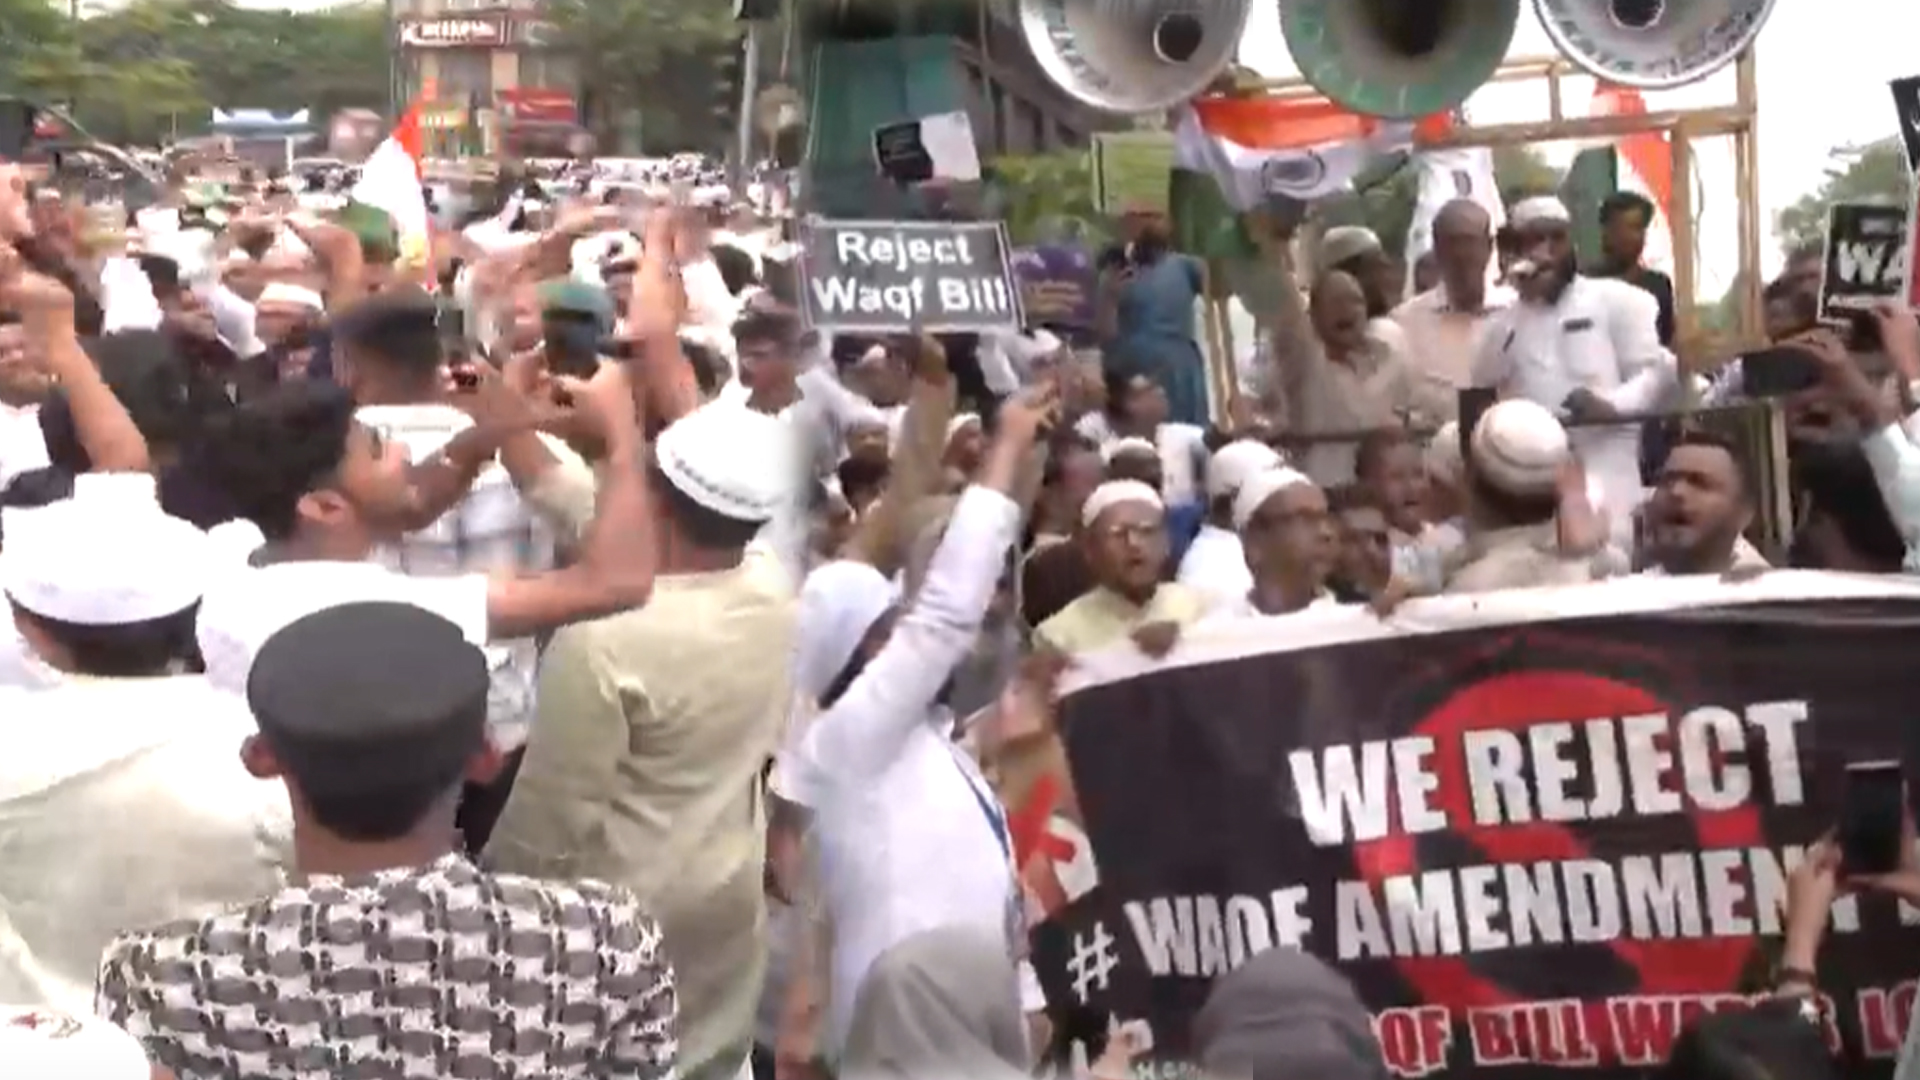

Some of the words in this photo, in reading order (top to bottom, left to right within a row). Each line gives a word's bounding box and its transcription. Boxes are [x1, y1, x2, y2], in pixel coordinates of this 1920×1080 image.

[837, 231, 973, 271] Reject
[812, 277, 925, 318] Waqf
[937, 276, 1009, 311] Bill
[1288, 735, 1447, 846] WE
[1463, 701, 1809, 826] REJECT
[1066, 920, 1120, 1005] #
[1336, 843, 1860, 962] AMENDMEN
[1367, 1003, 1454, 1078] QF
[1467, 997, 1599, 1067] BILL
